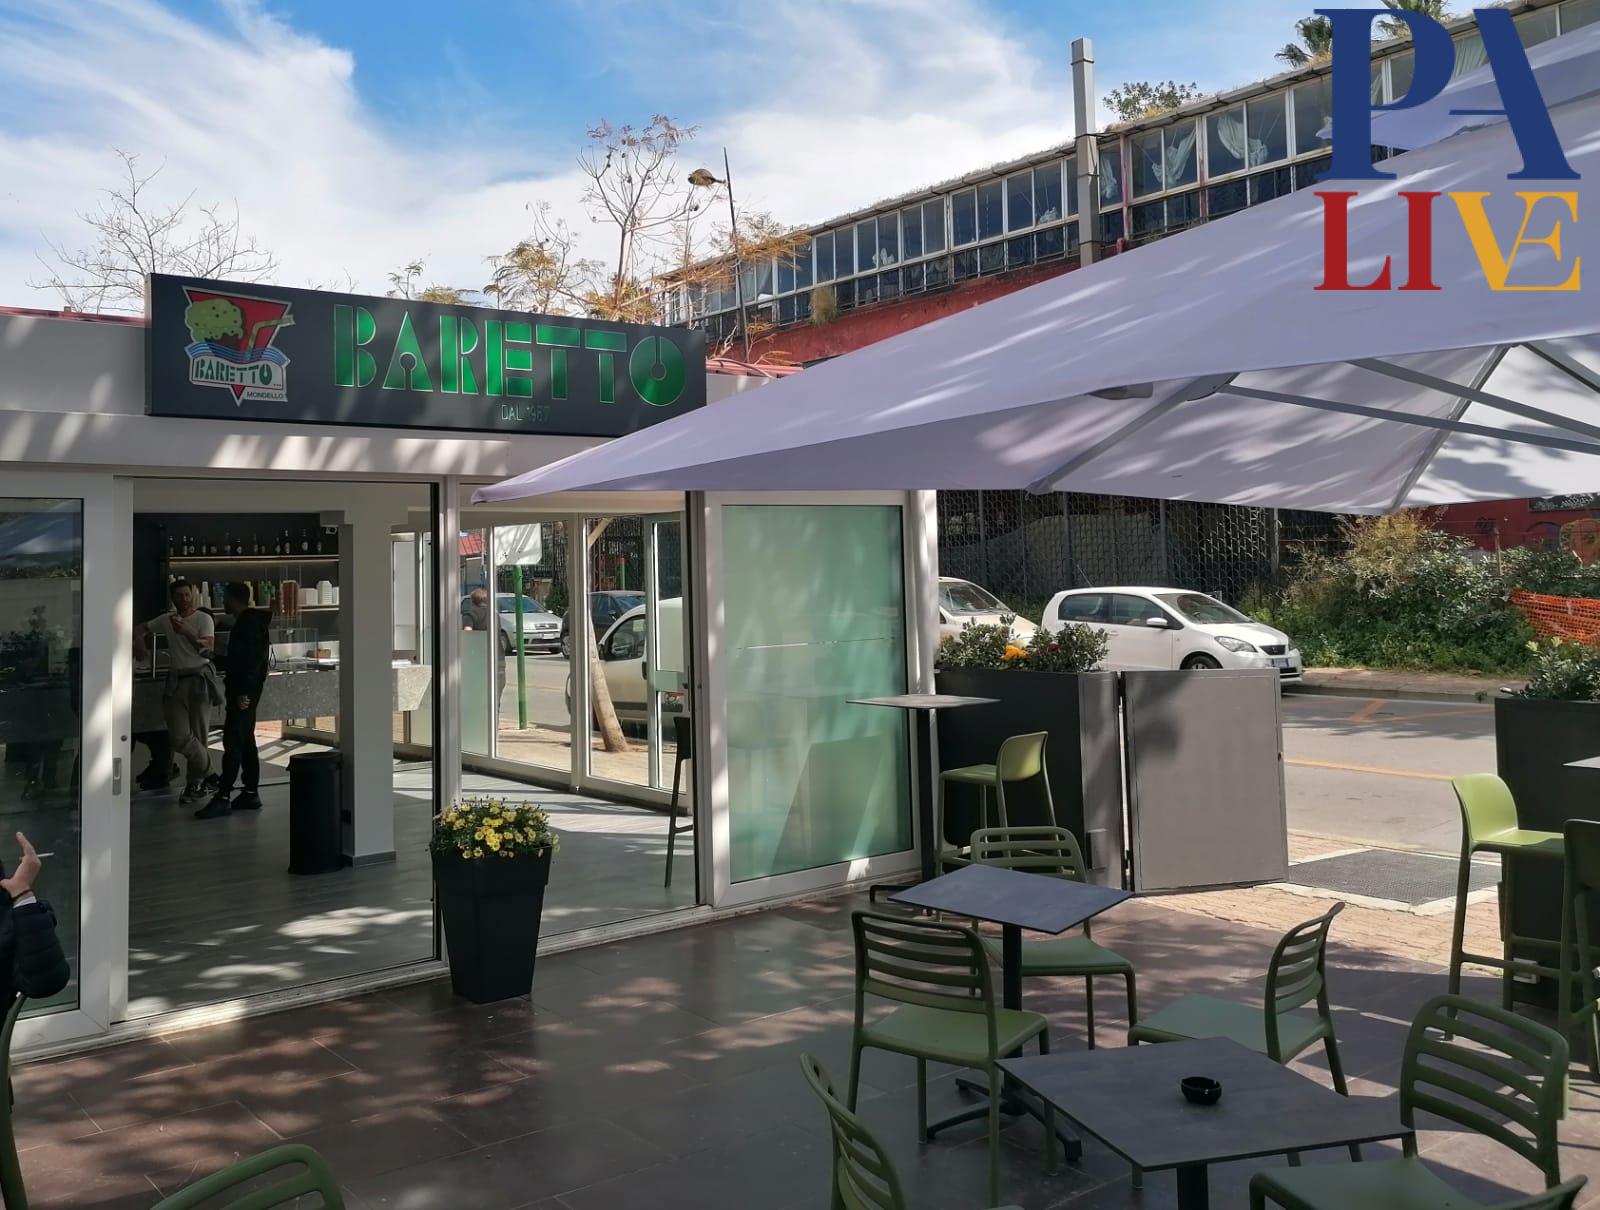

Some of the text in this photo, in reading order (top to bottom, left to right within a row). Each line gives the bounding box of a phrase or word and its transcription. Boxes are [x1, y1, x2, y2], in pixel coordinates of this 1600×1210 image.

[334, 303, 687, 407] BARETTO
[195, 359, 272, 386] BARETTO
[246, 391, 283, 399] MONDELLO
[501, 404, 523, 421] DAL
